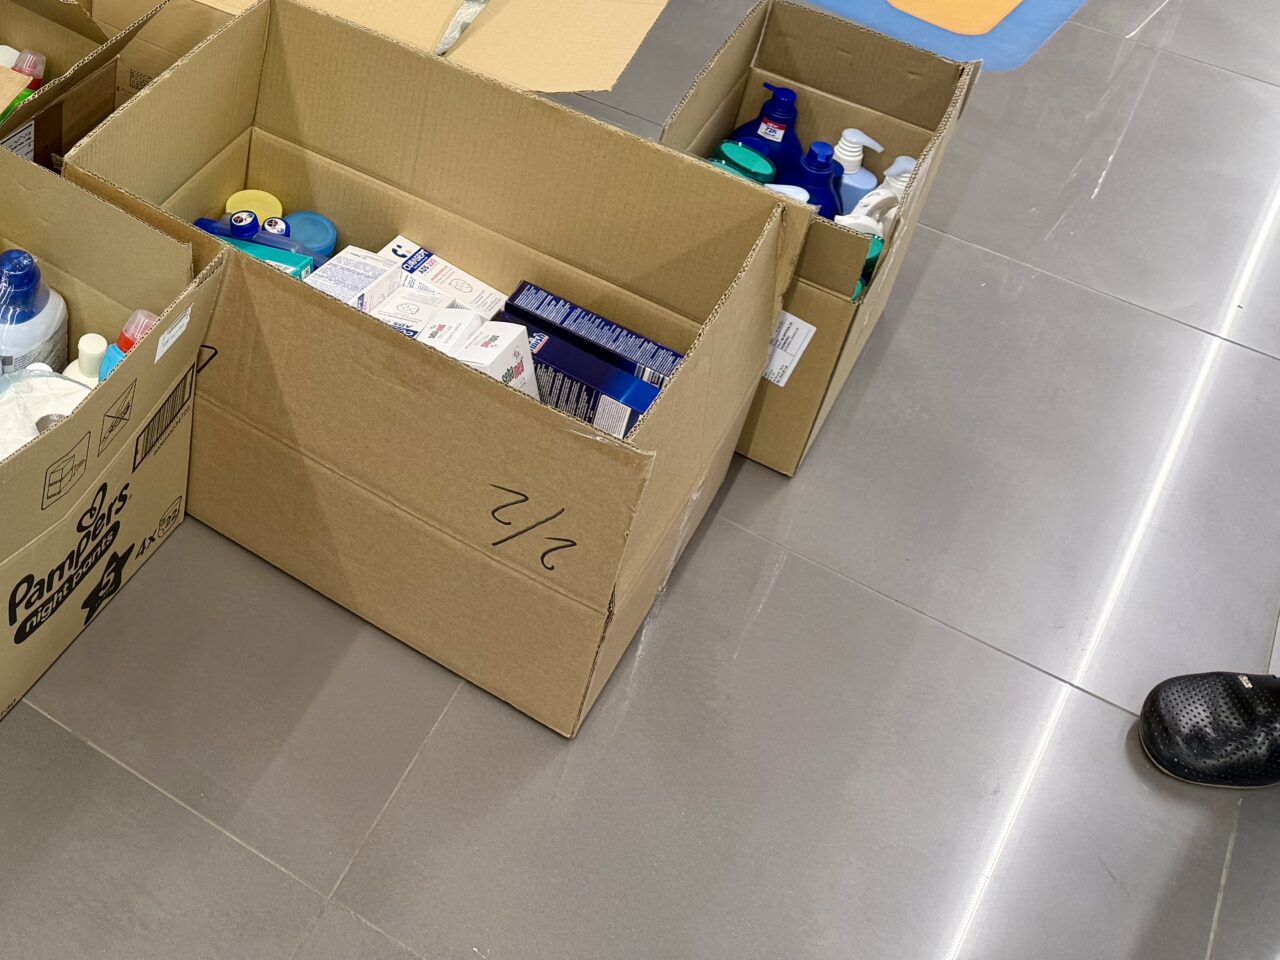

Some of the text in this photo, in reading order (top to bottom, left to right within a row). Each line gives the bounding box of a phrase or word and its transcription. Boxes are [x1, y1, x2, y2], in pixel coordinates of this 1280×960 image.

[9, 481, 130, 626] Pampers
[134, 528, 158, 560] 4x
[25, 530, 114, 633] night pants
[99, 561, 117, 597] 5
